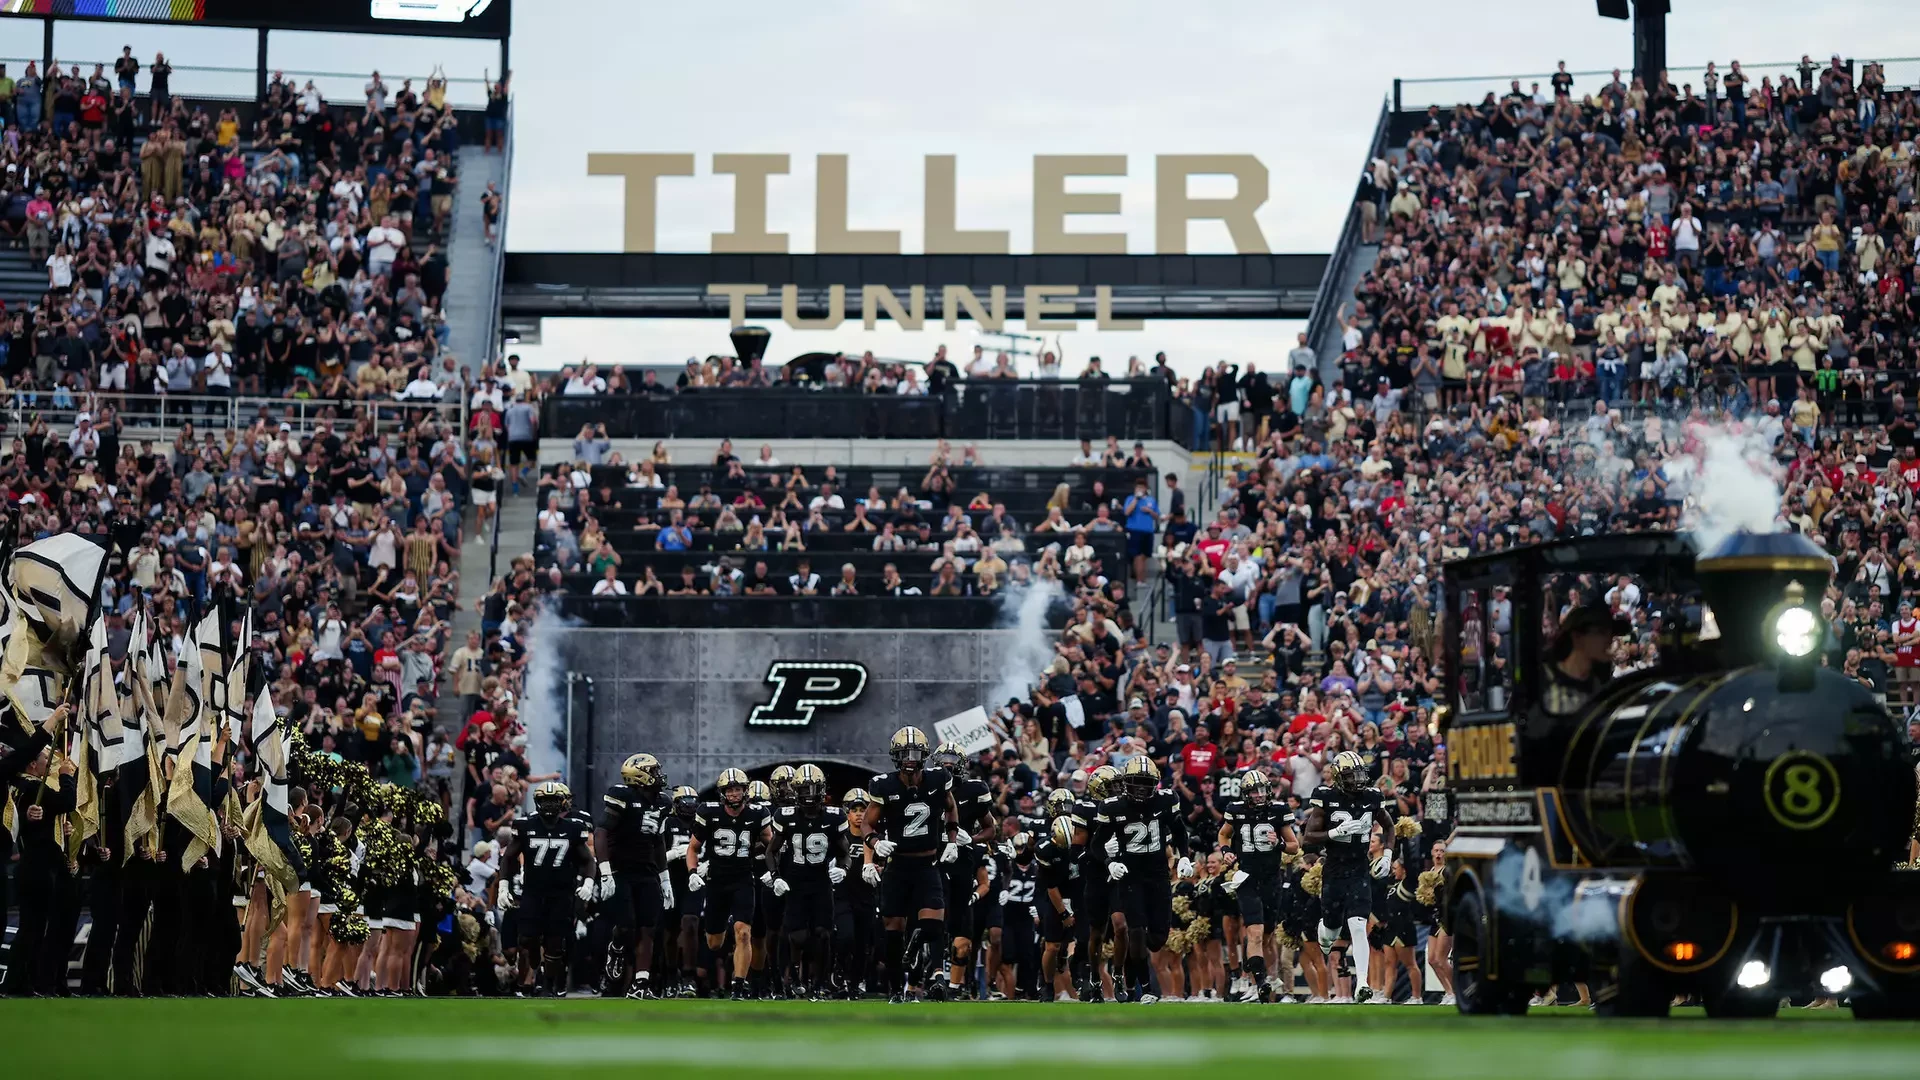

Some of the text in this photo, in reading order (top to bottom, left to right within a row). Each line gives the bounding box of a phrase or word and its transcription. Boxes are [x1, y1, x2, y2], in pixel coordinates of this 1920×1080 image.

[587, 153, 1271, 254] TILLER
[707, 284, 1145, 331] TUNNEL
[748, 661, 867, 726] P
[941, 723, 960, 741] HI
[1783, 765, 1821, 815] 8
[641, 810, 661, 834] 5
[903, 802, 931, 837] 2
[1123, 819, 1162, 853] 21
[1330, 810, 1373, 843] 24
[529, 838, 570, 867] 77
[713, 828, 751, 857] 31
[791, 832, 829, 865] 19
[1008, 879, 1036, 902] 22
